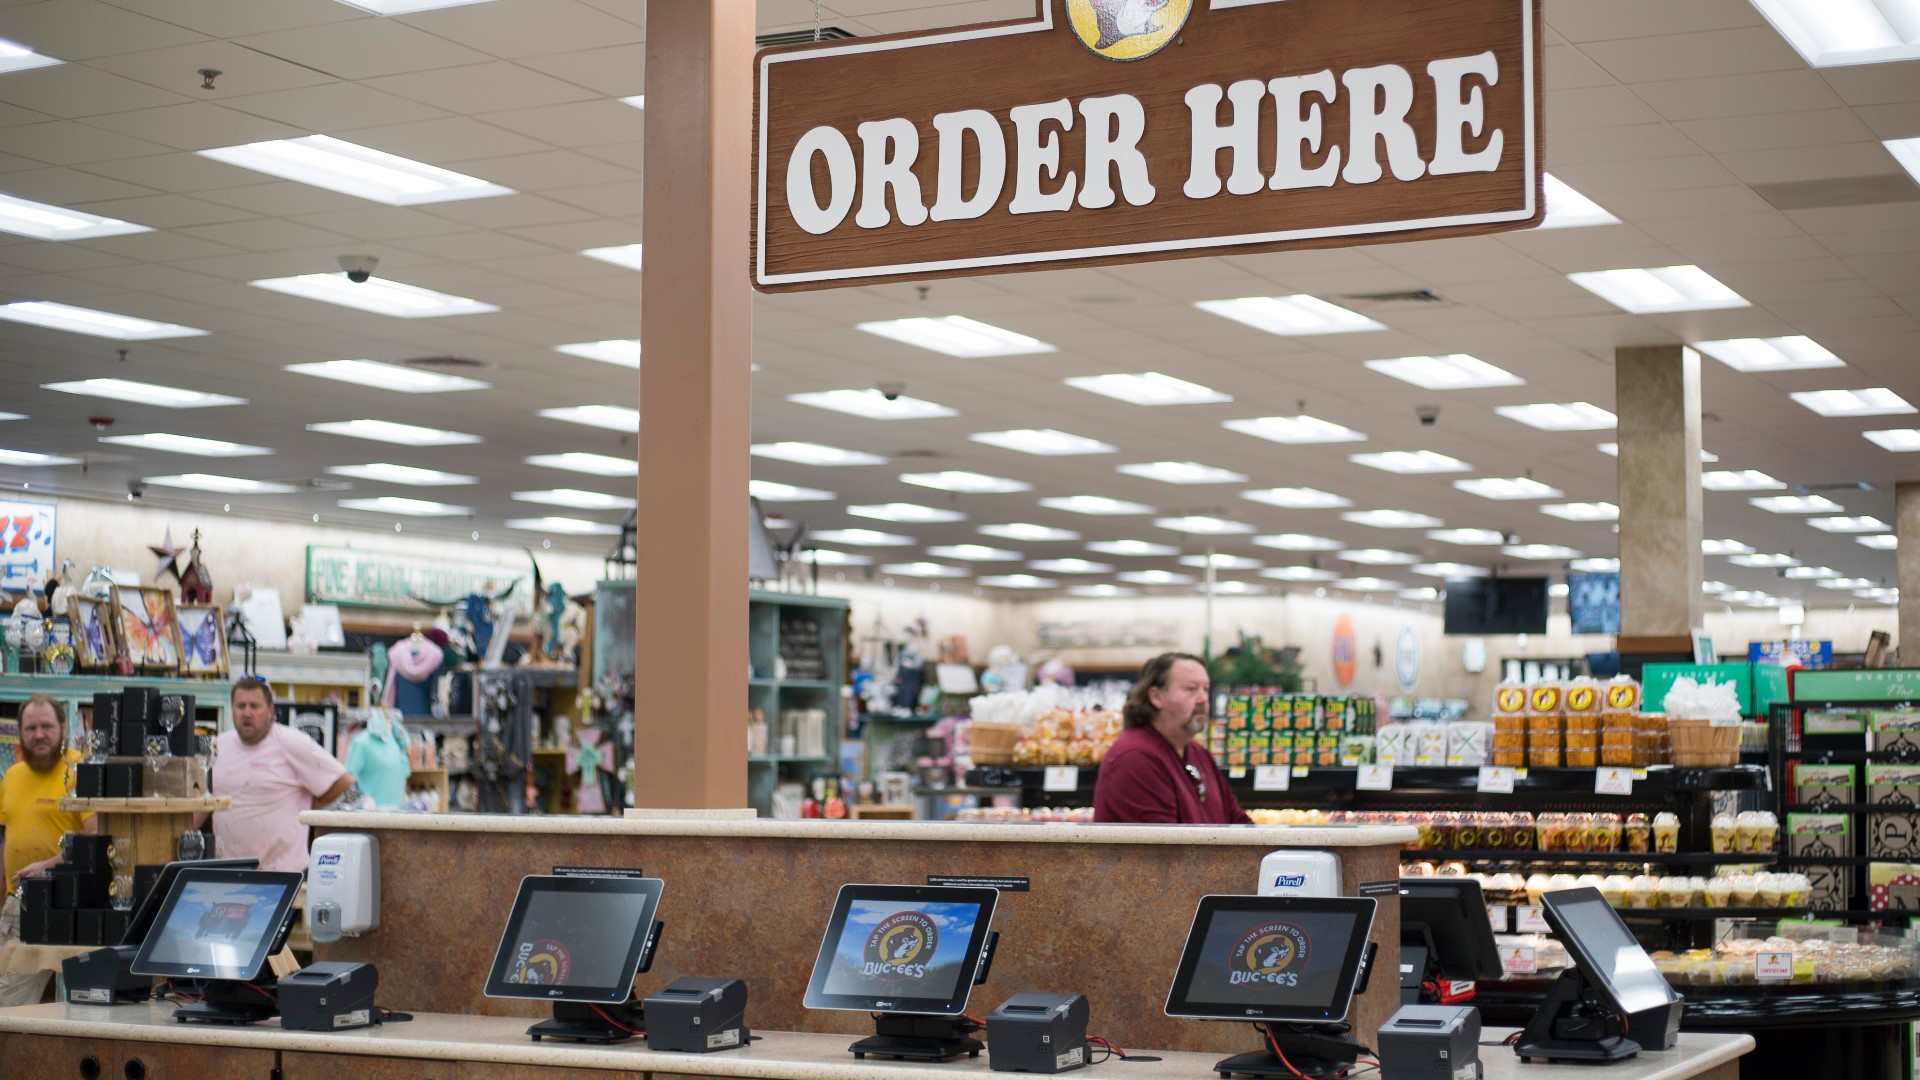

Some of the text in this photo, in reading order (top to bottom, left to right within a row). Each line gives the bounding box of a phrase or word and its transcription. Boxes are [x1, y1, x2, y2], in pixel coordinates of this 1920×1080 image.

[786, 50, 1504, 235] ORDER HERE
[1277, 876, 1303, 887] Purell
[870, 915, 934, 950] TAP THE SCREEN TO ORDER
[1236, 925, 1306, 959] TAP THE SCREEN TO ORDER
